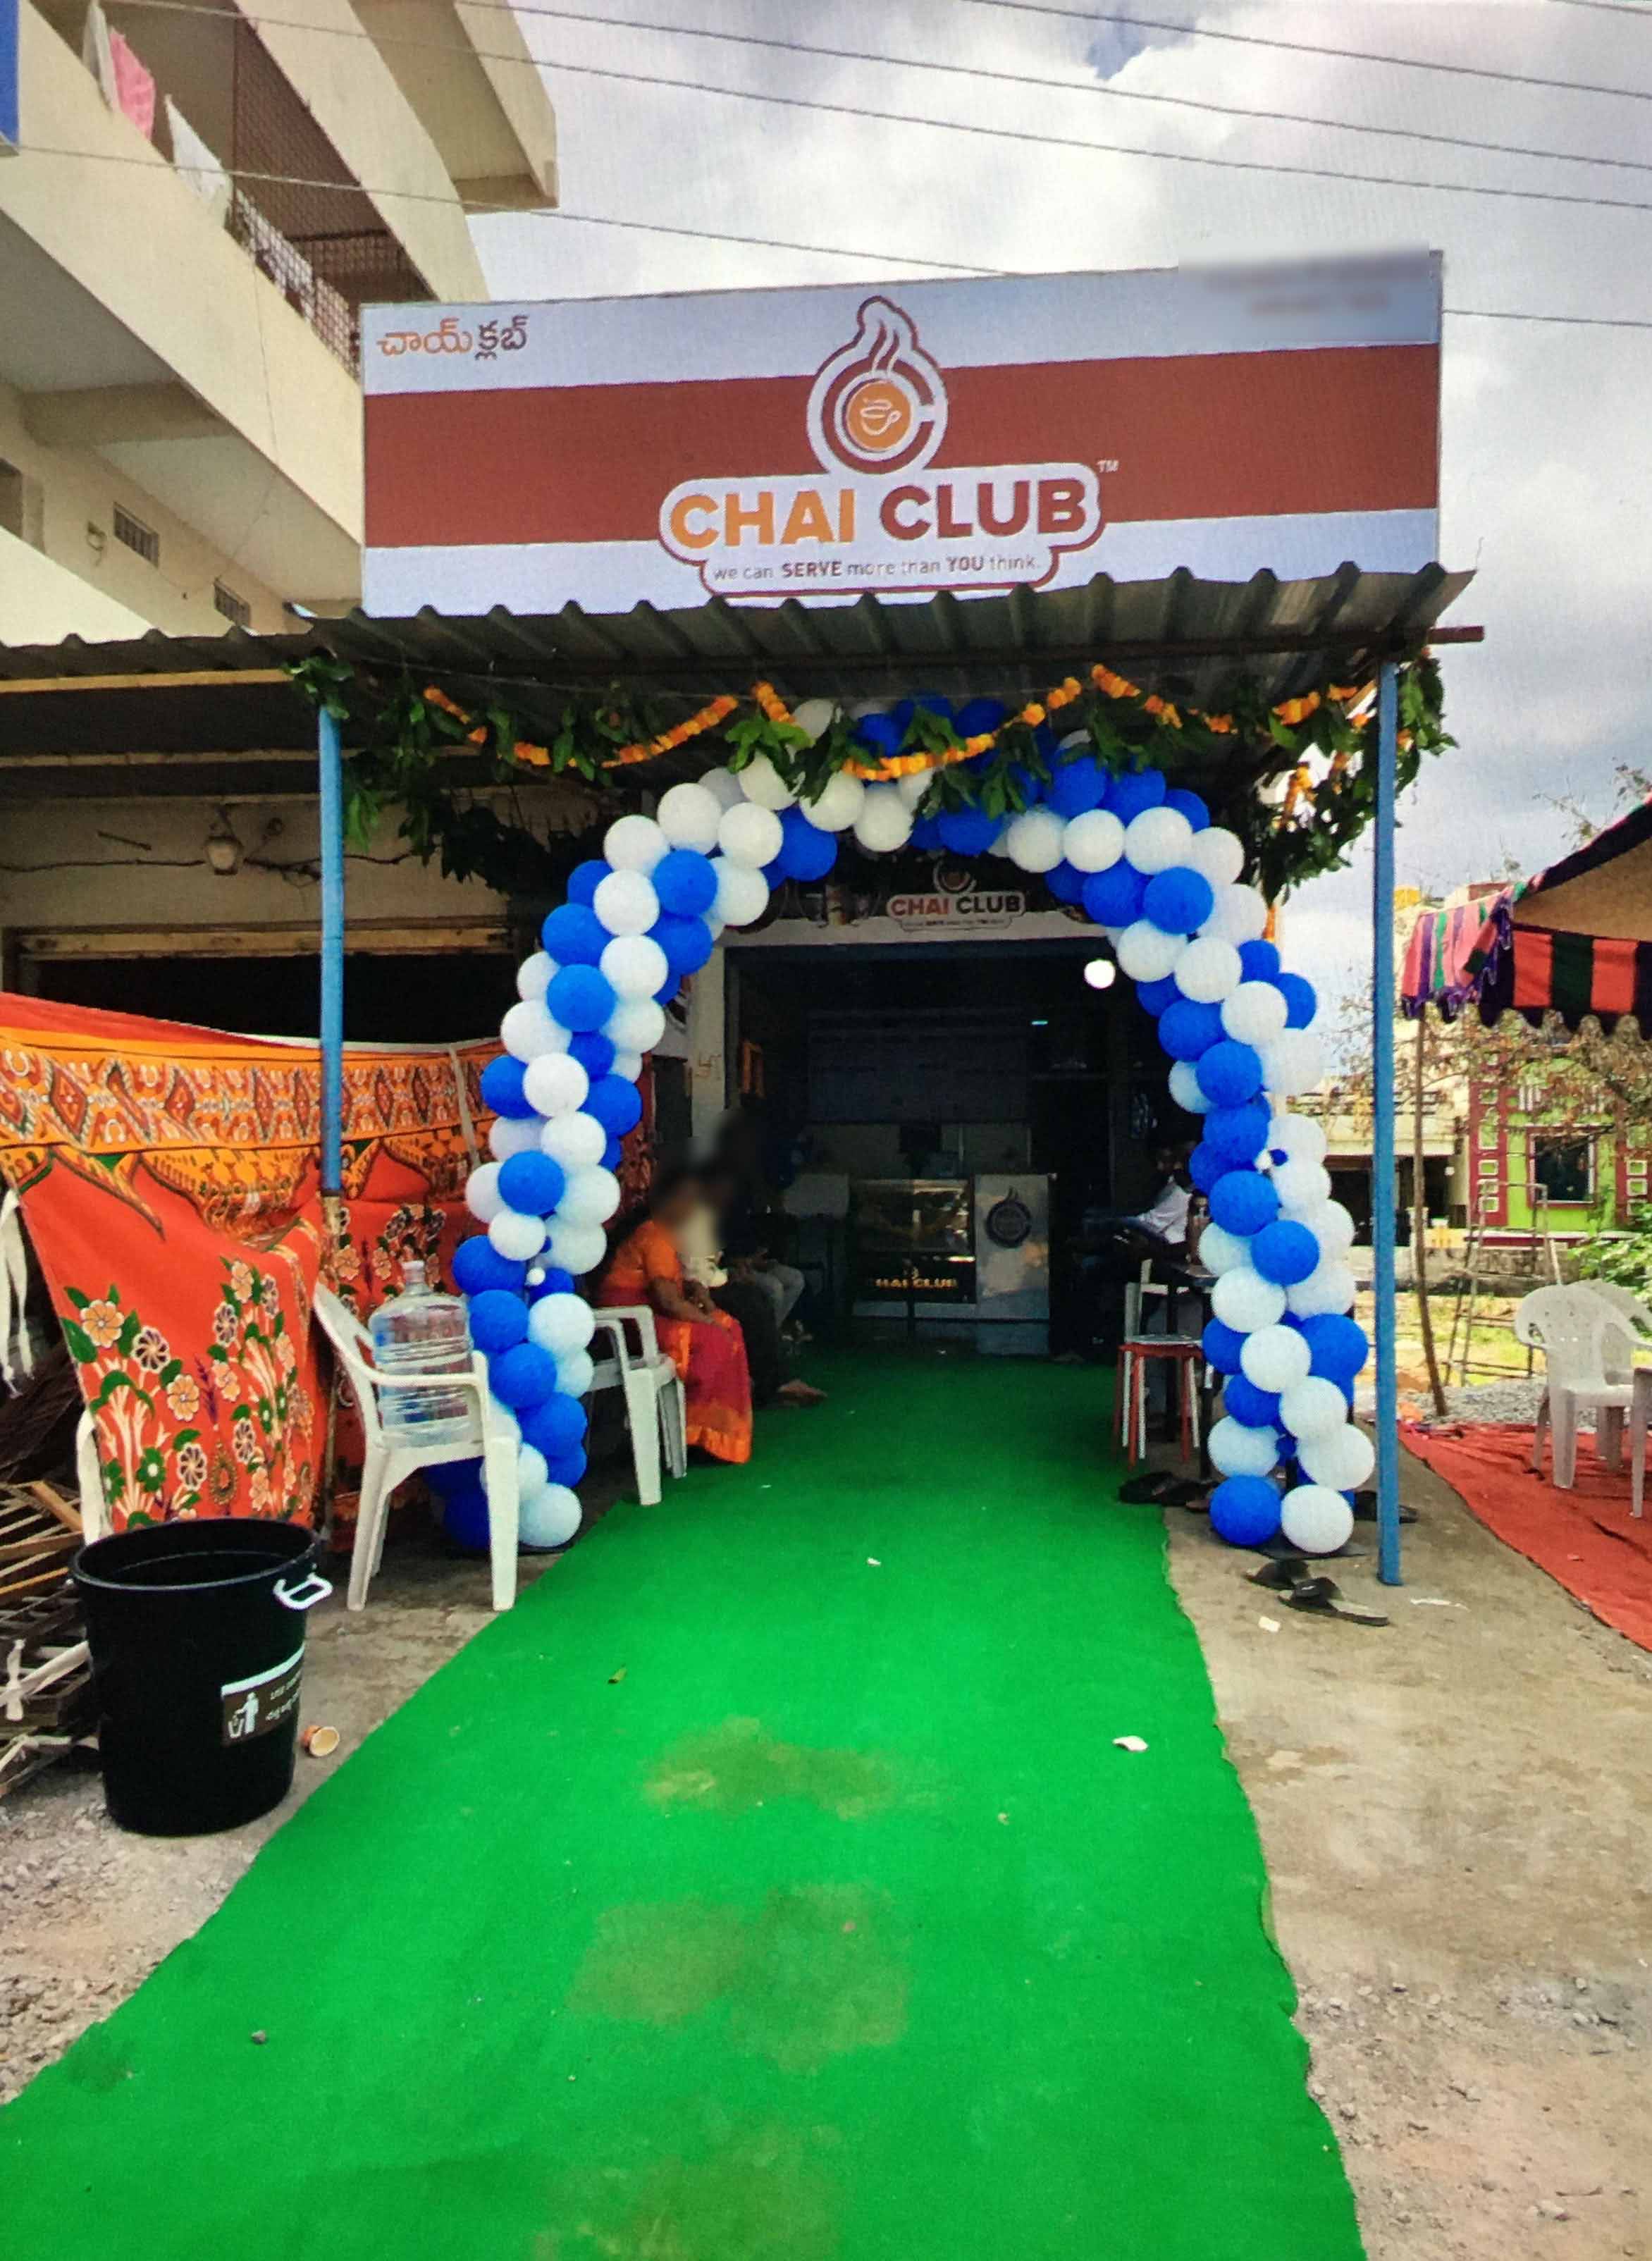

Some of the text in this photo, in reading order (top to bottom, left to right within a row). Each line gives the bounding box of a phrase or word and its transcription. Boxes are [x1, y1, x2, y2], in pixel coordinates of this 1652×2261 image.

[376, 315, 529, 361] చాయ్ క్లబ్
[670, 488, 855, 550] CHAI
[879, 477, 1087, 541] CLUB
[713, 566, 738, 581] we
[742, 566, 774, 580] can
[781, 560, 842, 578] SERVE
[847, 562, 894, 576] more
[901, 559, 941, 575] than
[946, 555, 985, 572] YOU
[890, 894, 1021, 916] CHAI CLUB
